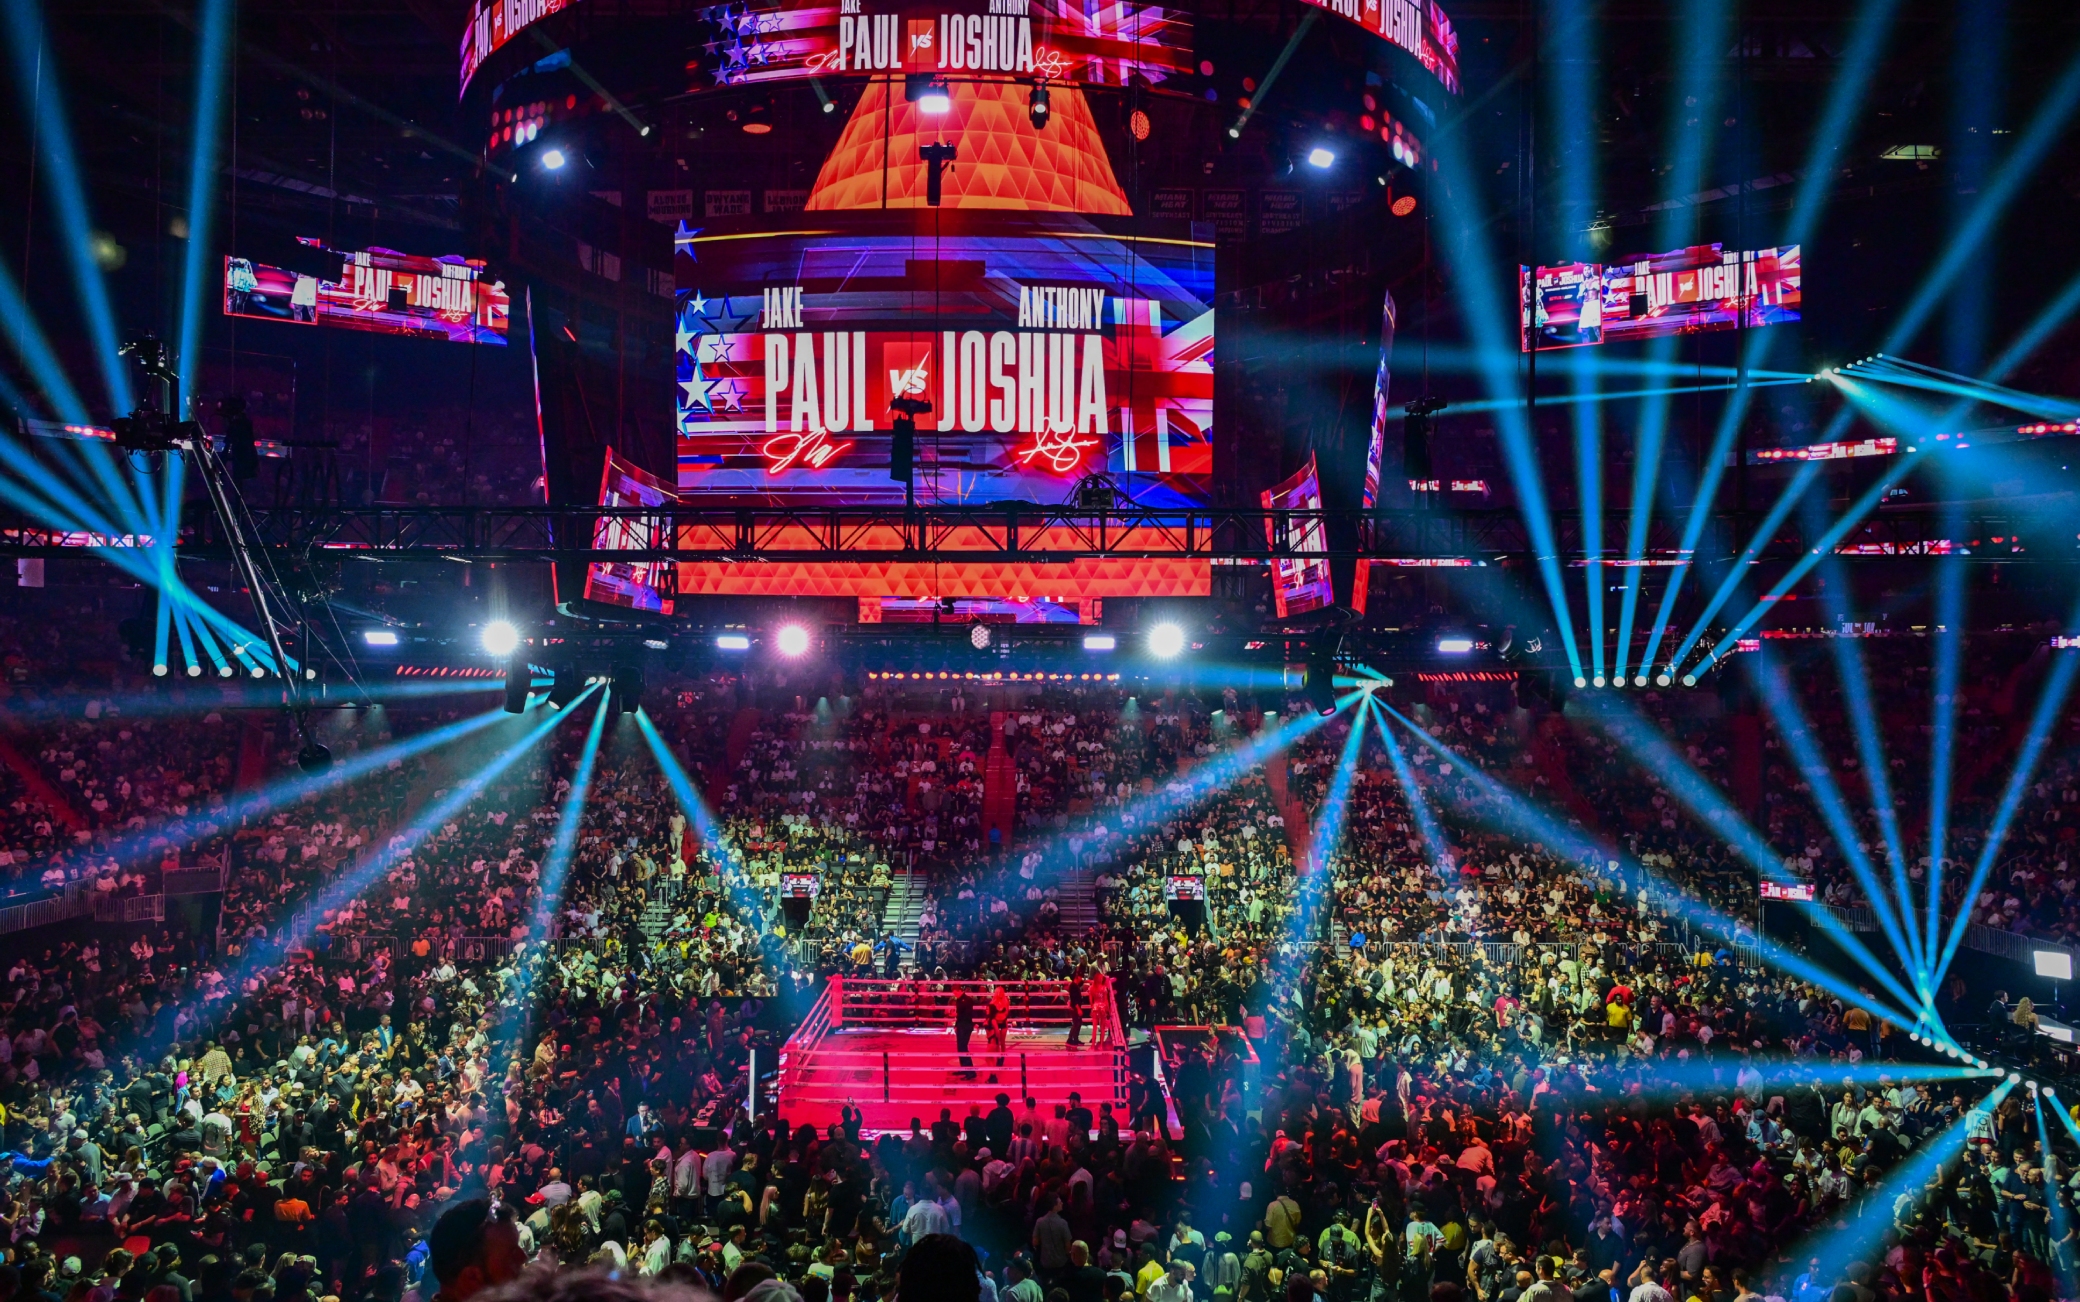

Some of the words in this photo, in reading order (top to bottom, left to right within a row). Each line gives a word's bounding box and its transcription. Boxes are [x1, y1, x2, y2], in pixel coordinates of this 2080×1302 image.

[839, 14, 902, 71] PAUL
[938, 14, 1033, 71] JOSHUA
[654, 195, 687, 204] ALONZO
[707, 195, 750, 204] DWYANE
[649, 205, 691, 214] MOURNING
[714, 205, 743, 214] WADE
[355, 251, 371, 267] JAKE
[415, 274, 471, 313] JOSHUA
[762, 287, 804, 328] JAKE
[1018, 286, 1104, 330] ANTHONY
[764, 331, 874, 433] PAUL
[937, 331, 1109, 434] JOSHUA
